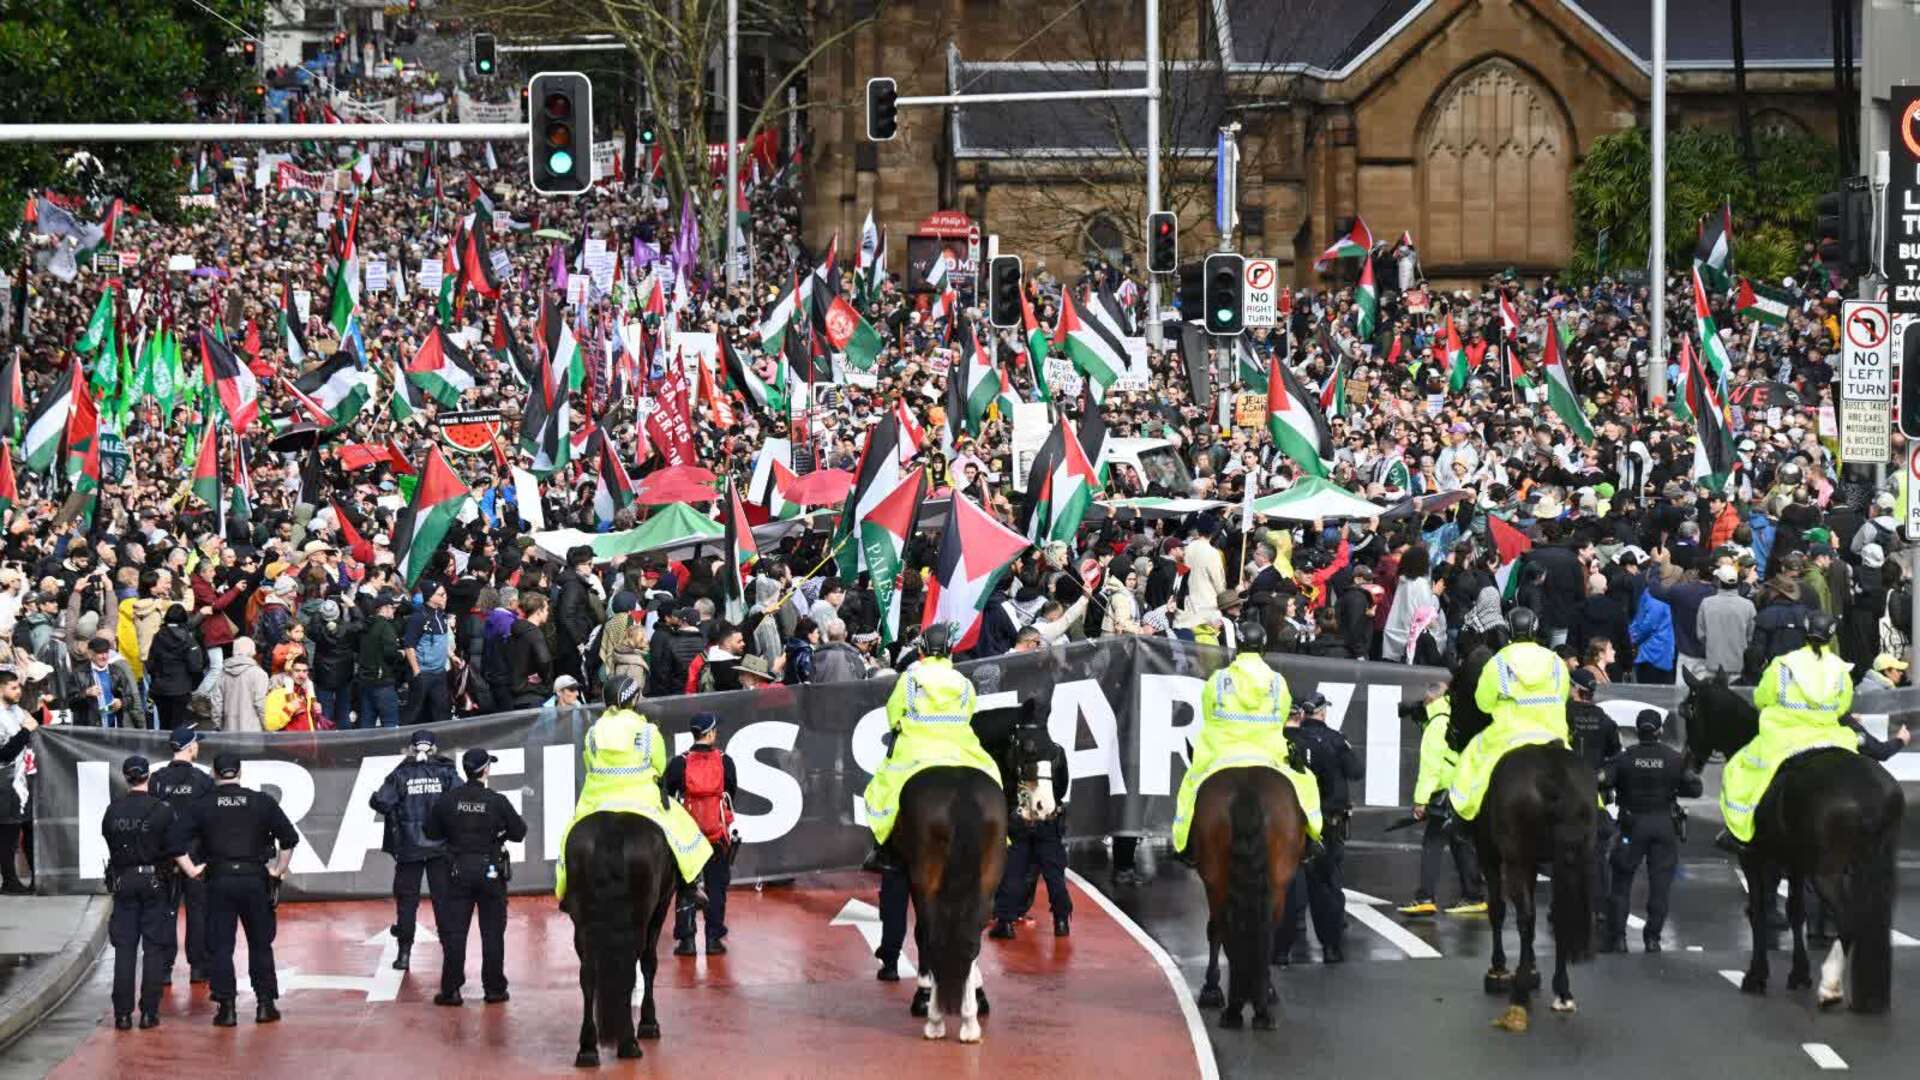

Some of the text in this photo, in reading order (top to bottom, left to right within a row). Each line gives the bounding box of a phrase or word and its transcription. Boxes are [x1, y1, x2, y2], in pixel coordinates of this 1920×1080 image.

[1251, 292, 1268, 303] NO
[1247, 305, 1272, 313] RIGHT
[1854, 352, 1879, 366] NO
[1849, 369, 1884, 380] LEFT
[1848, 383, 1886, 395] TURN
[440, 414, 502, 425] FREE PALESTINE
[1854, 436, 1885, 446] BICYCLES
[1845, 448, 1885, 458] EXCEPTED
[1634, 757, 1664, 769] POLICE
[457, 801, 487, 813] POLICE
